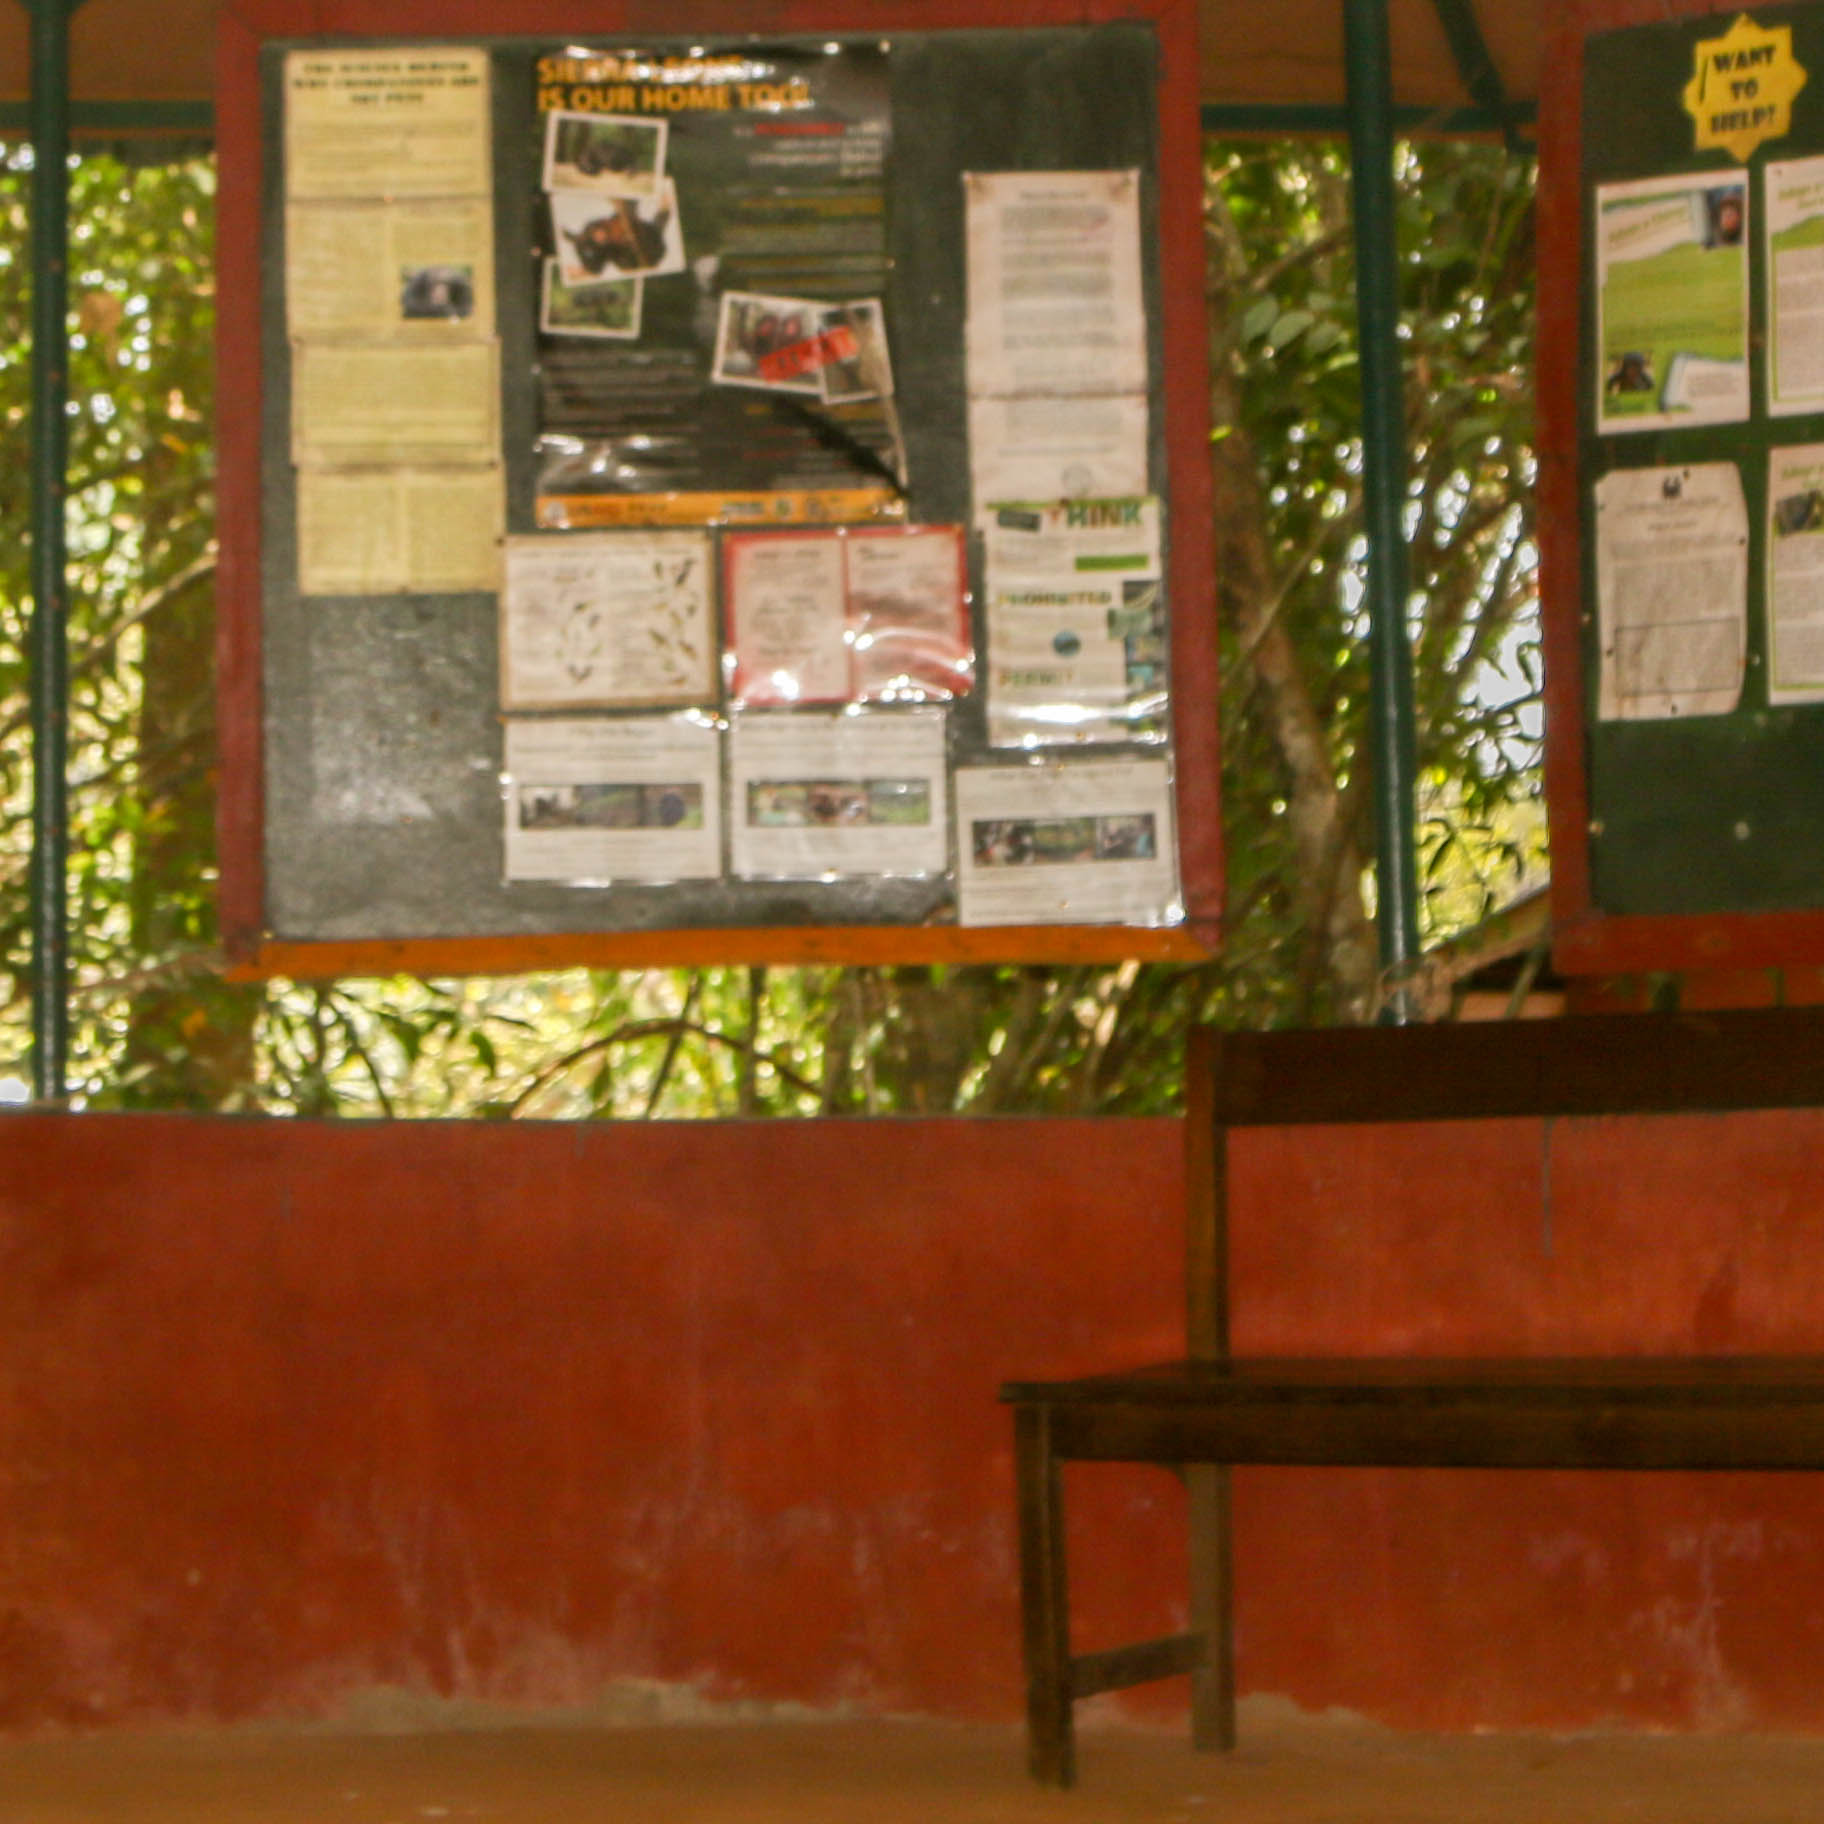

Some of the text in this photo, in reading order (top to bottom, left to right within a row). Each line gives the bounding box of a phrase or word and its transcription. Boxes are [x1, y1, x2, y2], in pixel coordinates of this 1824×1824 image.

[1712, 43, 1776, 74] WANT
[538, 87, 566, 112] IS
[574, 86, 636, 112] OUR
[642, 85, 732, 112] HOME
[1730, 78, 1759, 101] TO
